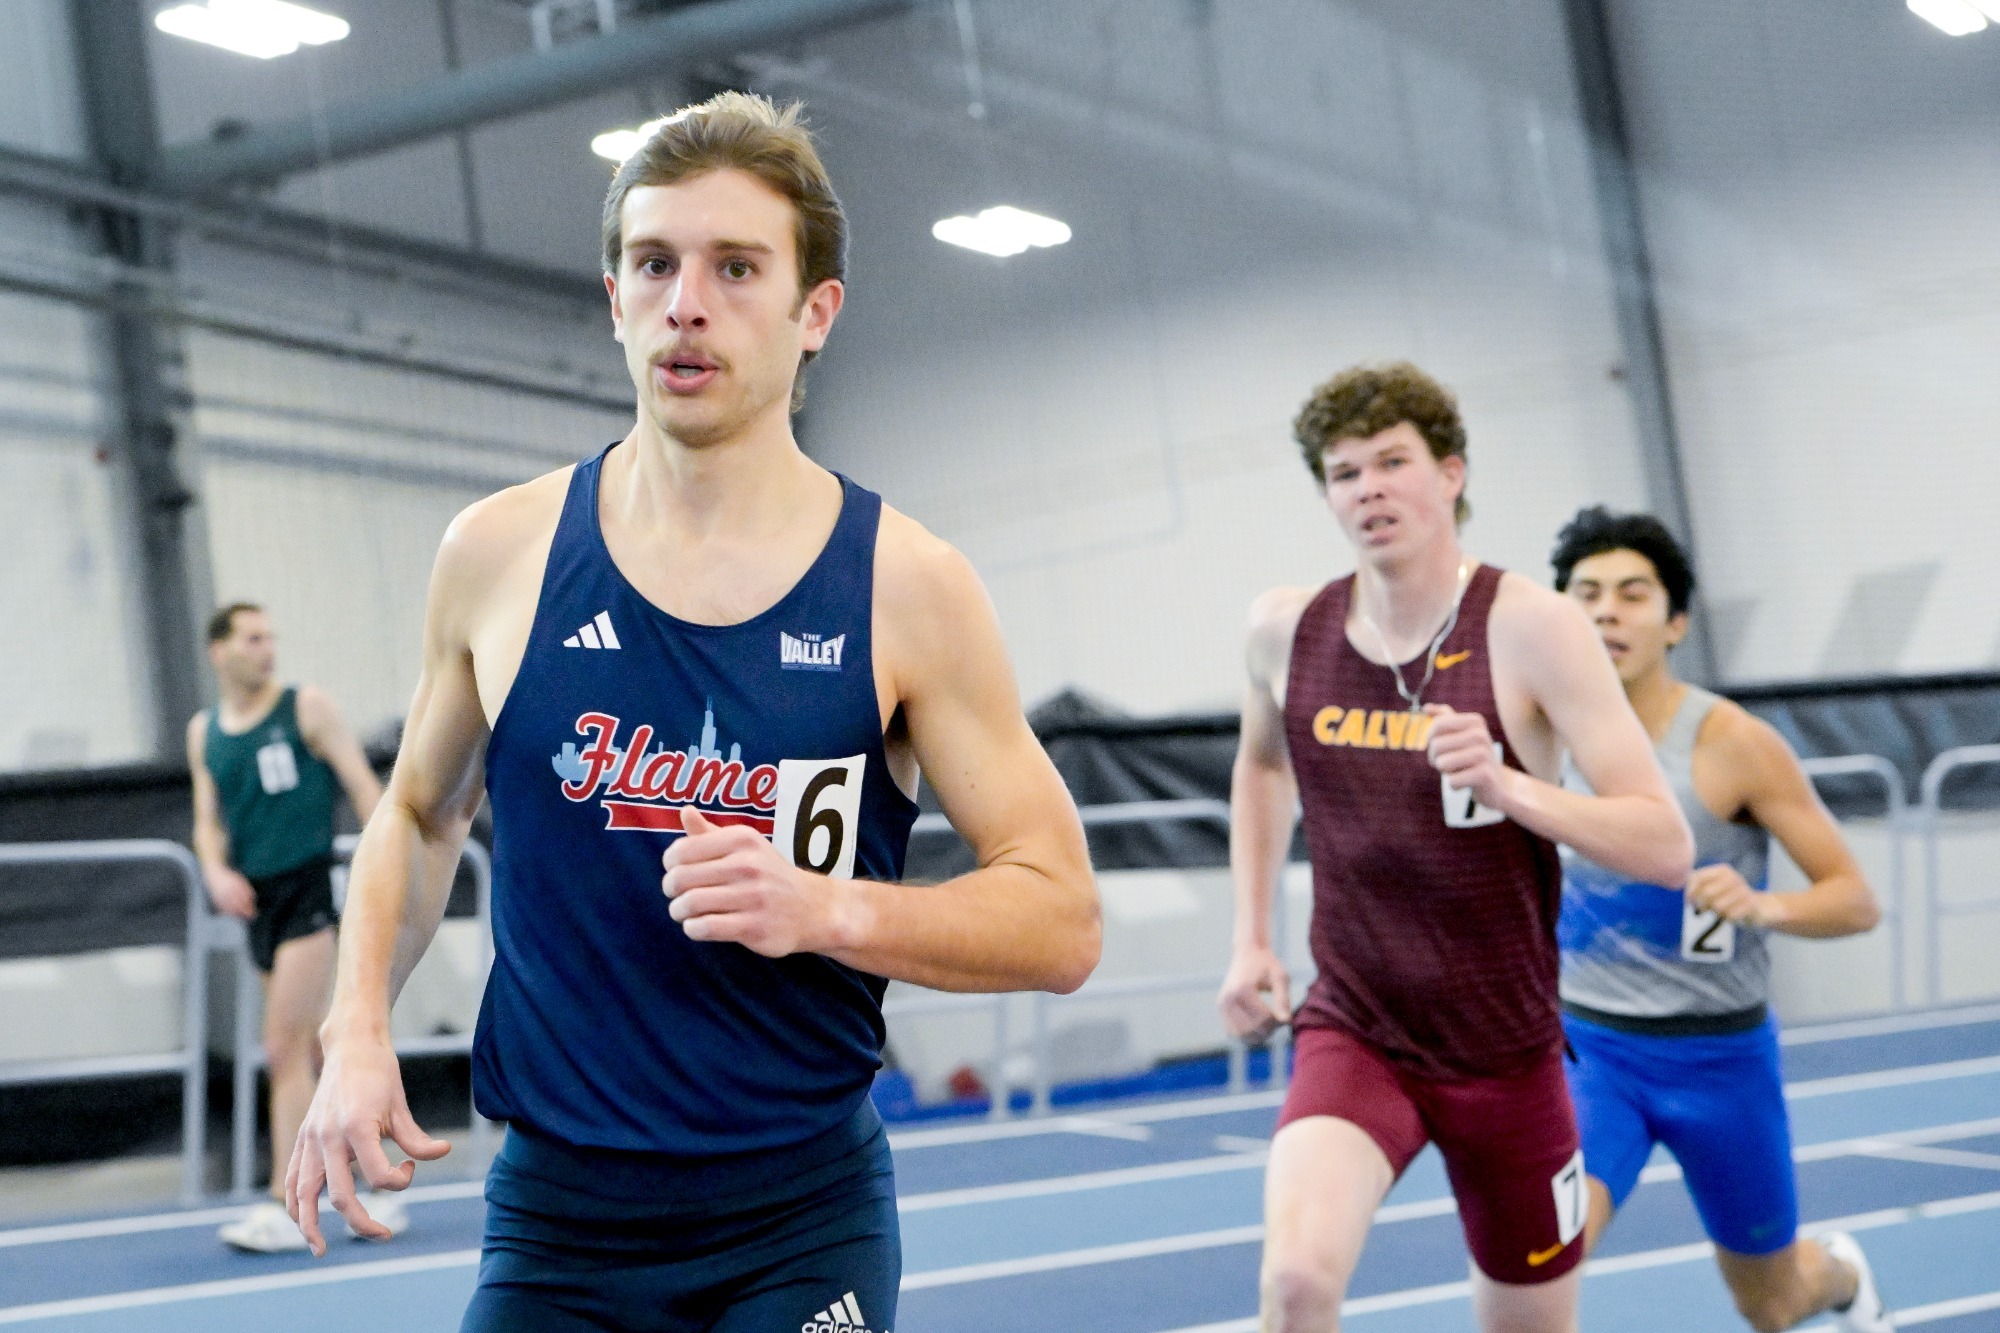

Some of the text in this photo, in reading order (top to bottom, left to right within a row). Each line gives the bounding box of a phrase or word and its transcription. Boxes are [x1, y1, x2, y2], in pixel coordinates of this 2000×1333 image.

[780, 631, 846, 666] VALLEY
[802, 633, 822, 642] THE
[561, 711, 778, 811] Flame
[793, 766, 849, 877] 6
[1691, 904, 1723, 953] 2
